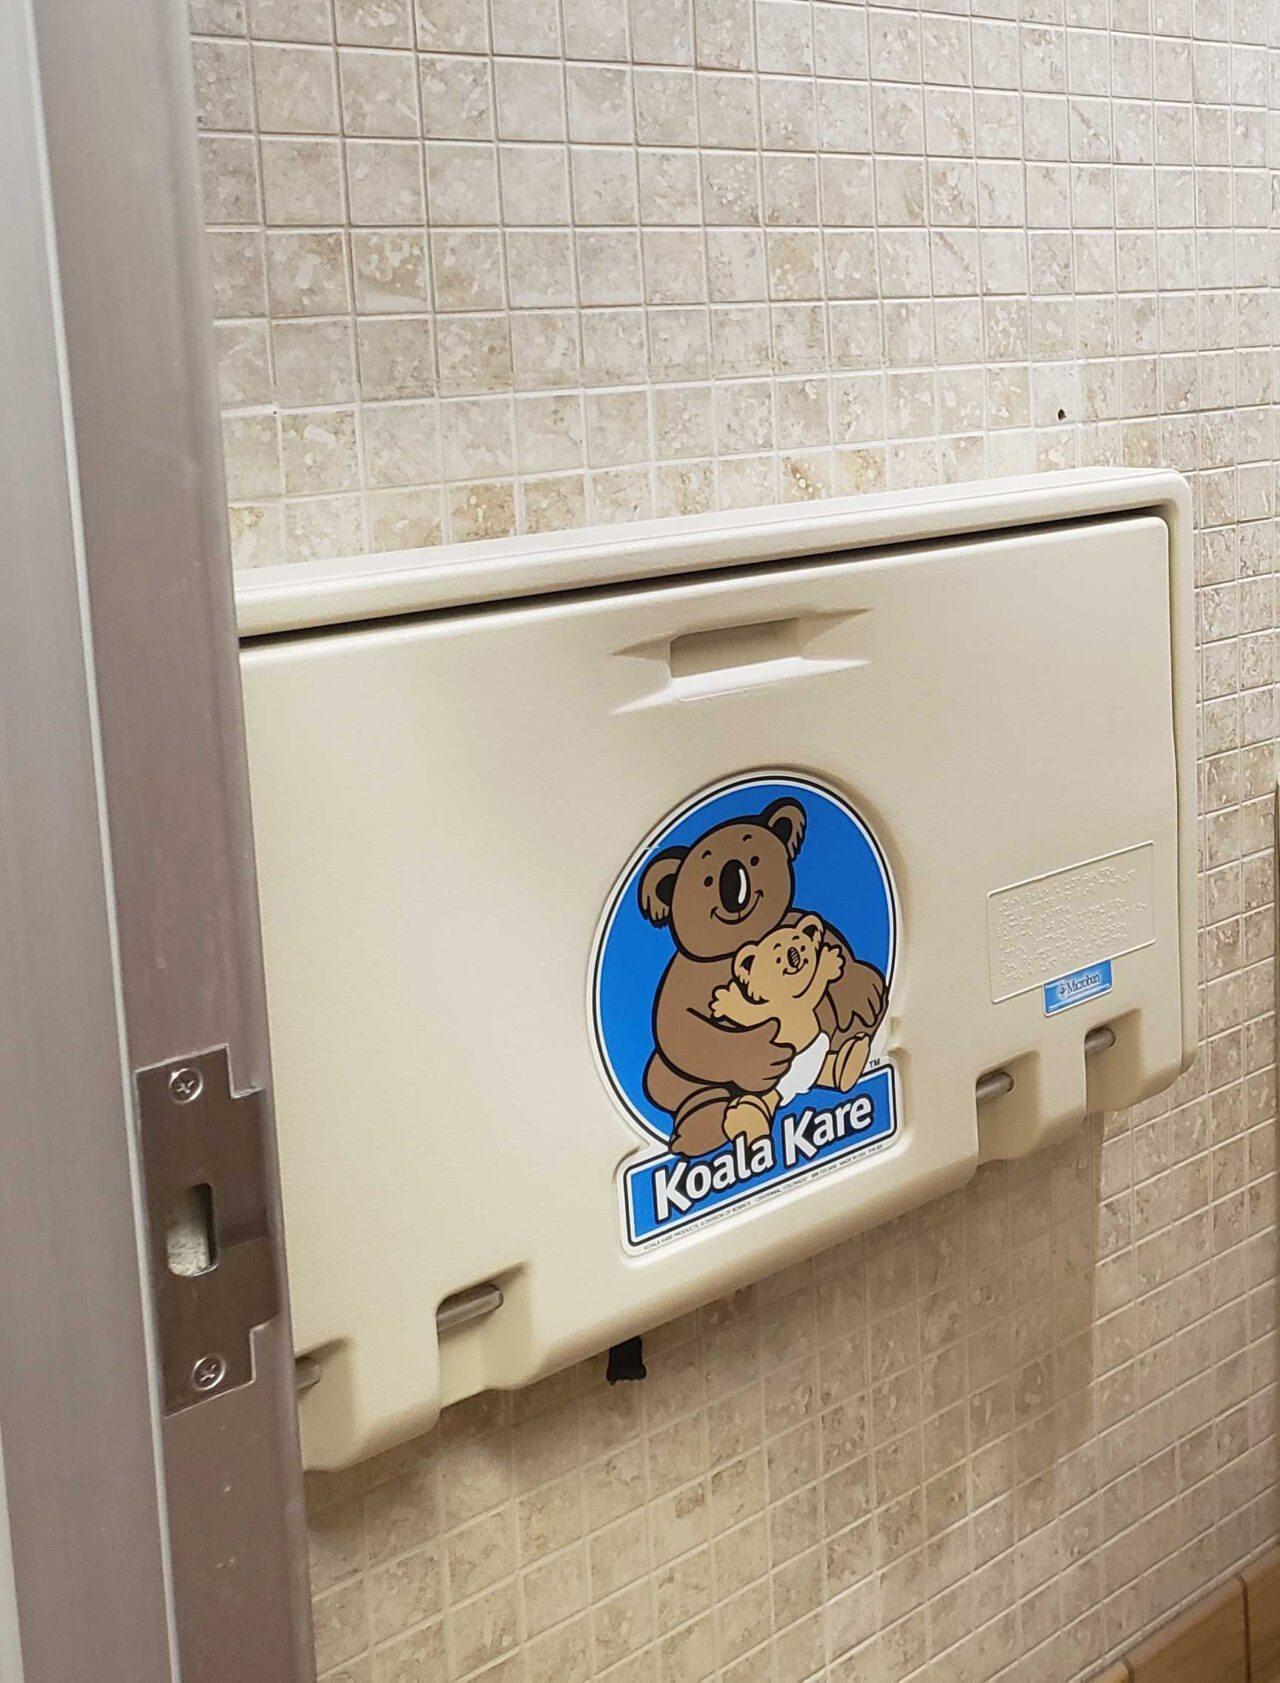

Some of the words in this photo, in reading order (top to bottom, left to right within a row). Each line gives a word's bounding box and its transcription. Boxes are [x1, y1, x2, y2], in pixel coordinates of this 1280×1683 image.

[1066, 974, 1100, 994] Microban
[654, 1135, 774, 1221] Koala
[784, 1097, 872, 1166] Kare
